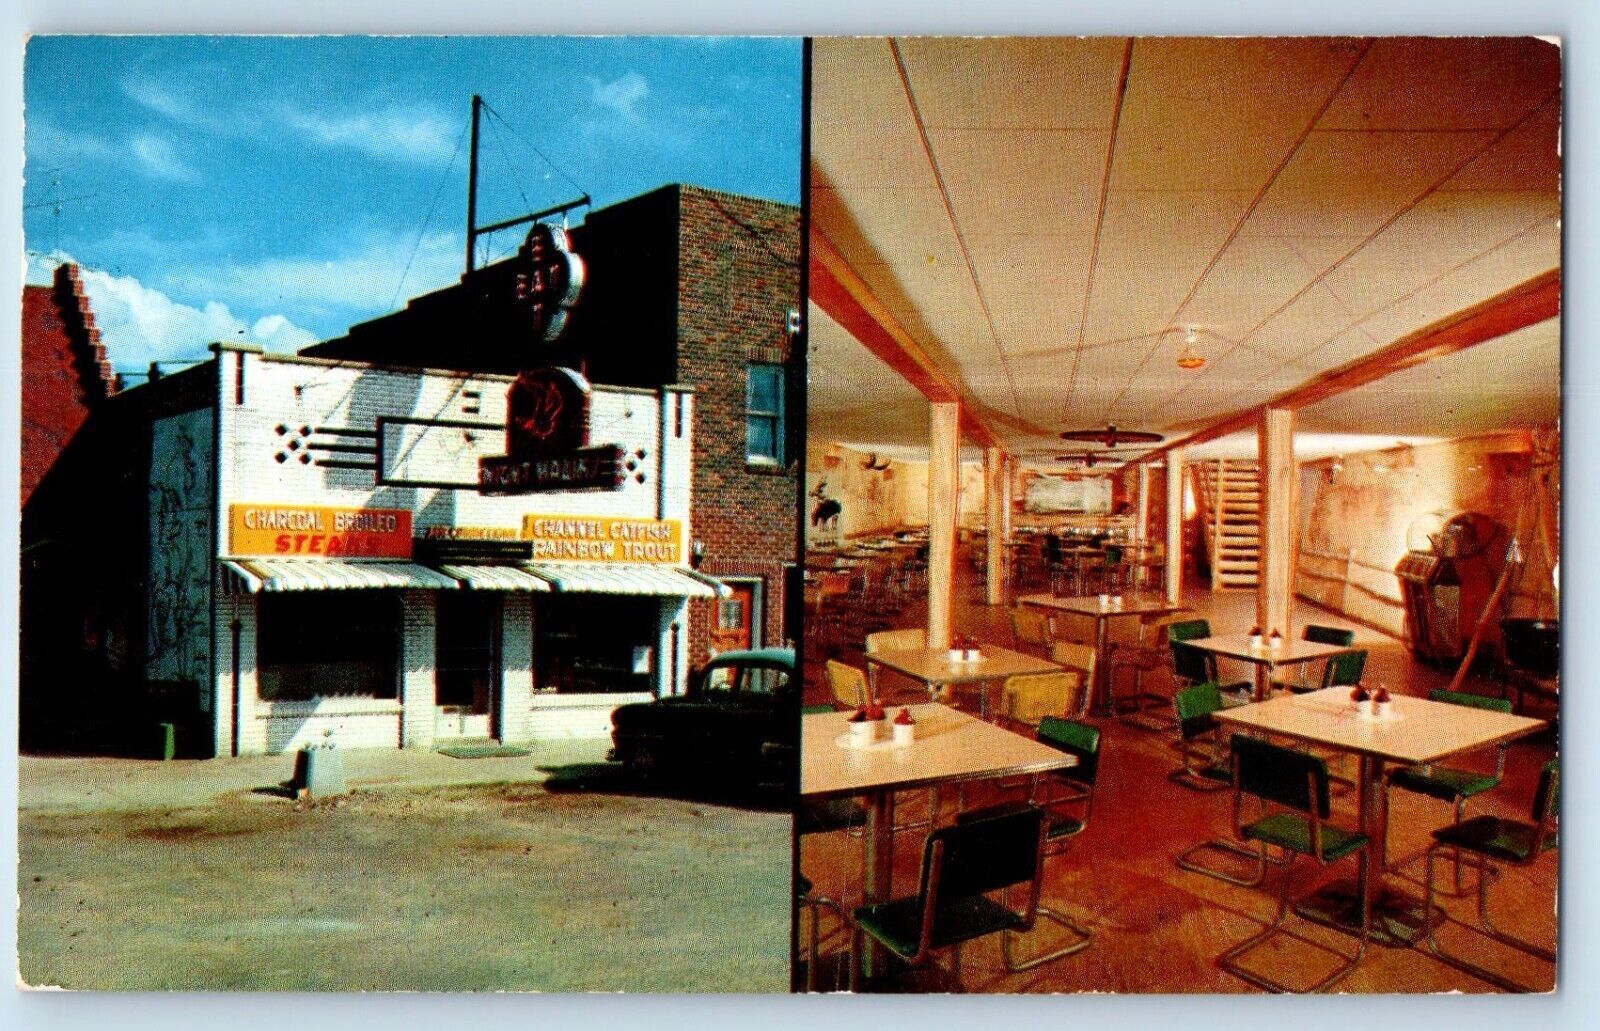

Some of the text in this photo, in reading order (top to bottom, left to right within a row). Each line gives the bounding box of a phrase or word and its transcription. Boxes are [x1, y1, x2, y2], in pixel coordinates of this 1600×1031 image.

[244, 508, 397, 533] CHARCOAL BROILED
[533, 518, 605, 540] CHANNEL
[609, 521, 672, 542] CATFISH
[532, 539, 616, 560] RAINBOW
[621, 541, 676, 562] TROUT
